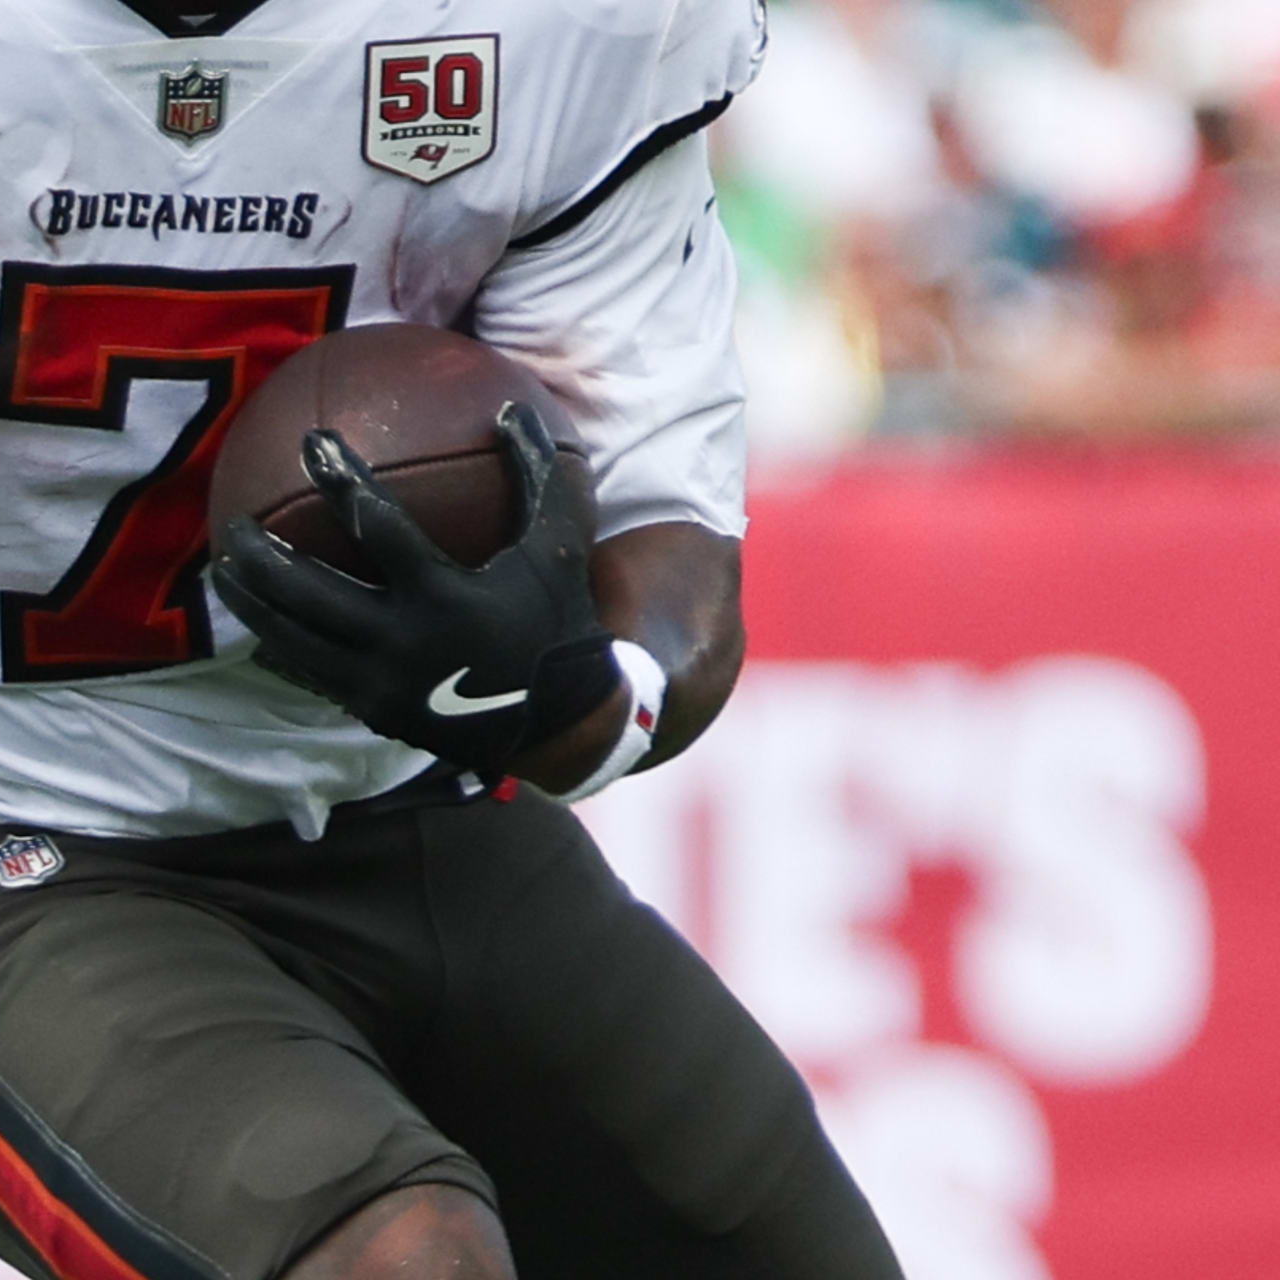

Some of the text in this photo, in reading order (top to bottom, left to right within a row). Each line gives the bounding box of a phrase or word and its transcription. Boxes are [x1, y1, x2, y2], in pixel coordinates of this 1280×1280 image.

[379, 52, 483, 125] 50
[169, 101, 219, 132] NFL
[395, 125, 466, 139] SEASONS
[47, 188, 320, 242] BUCCANEERS
[2, 848, 55, 878] NFL
